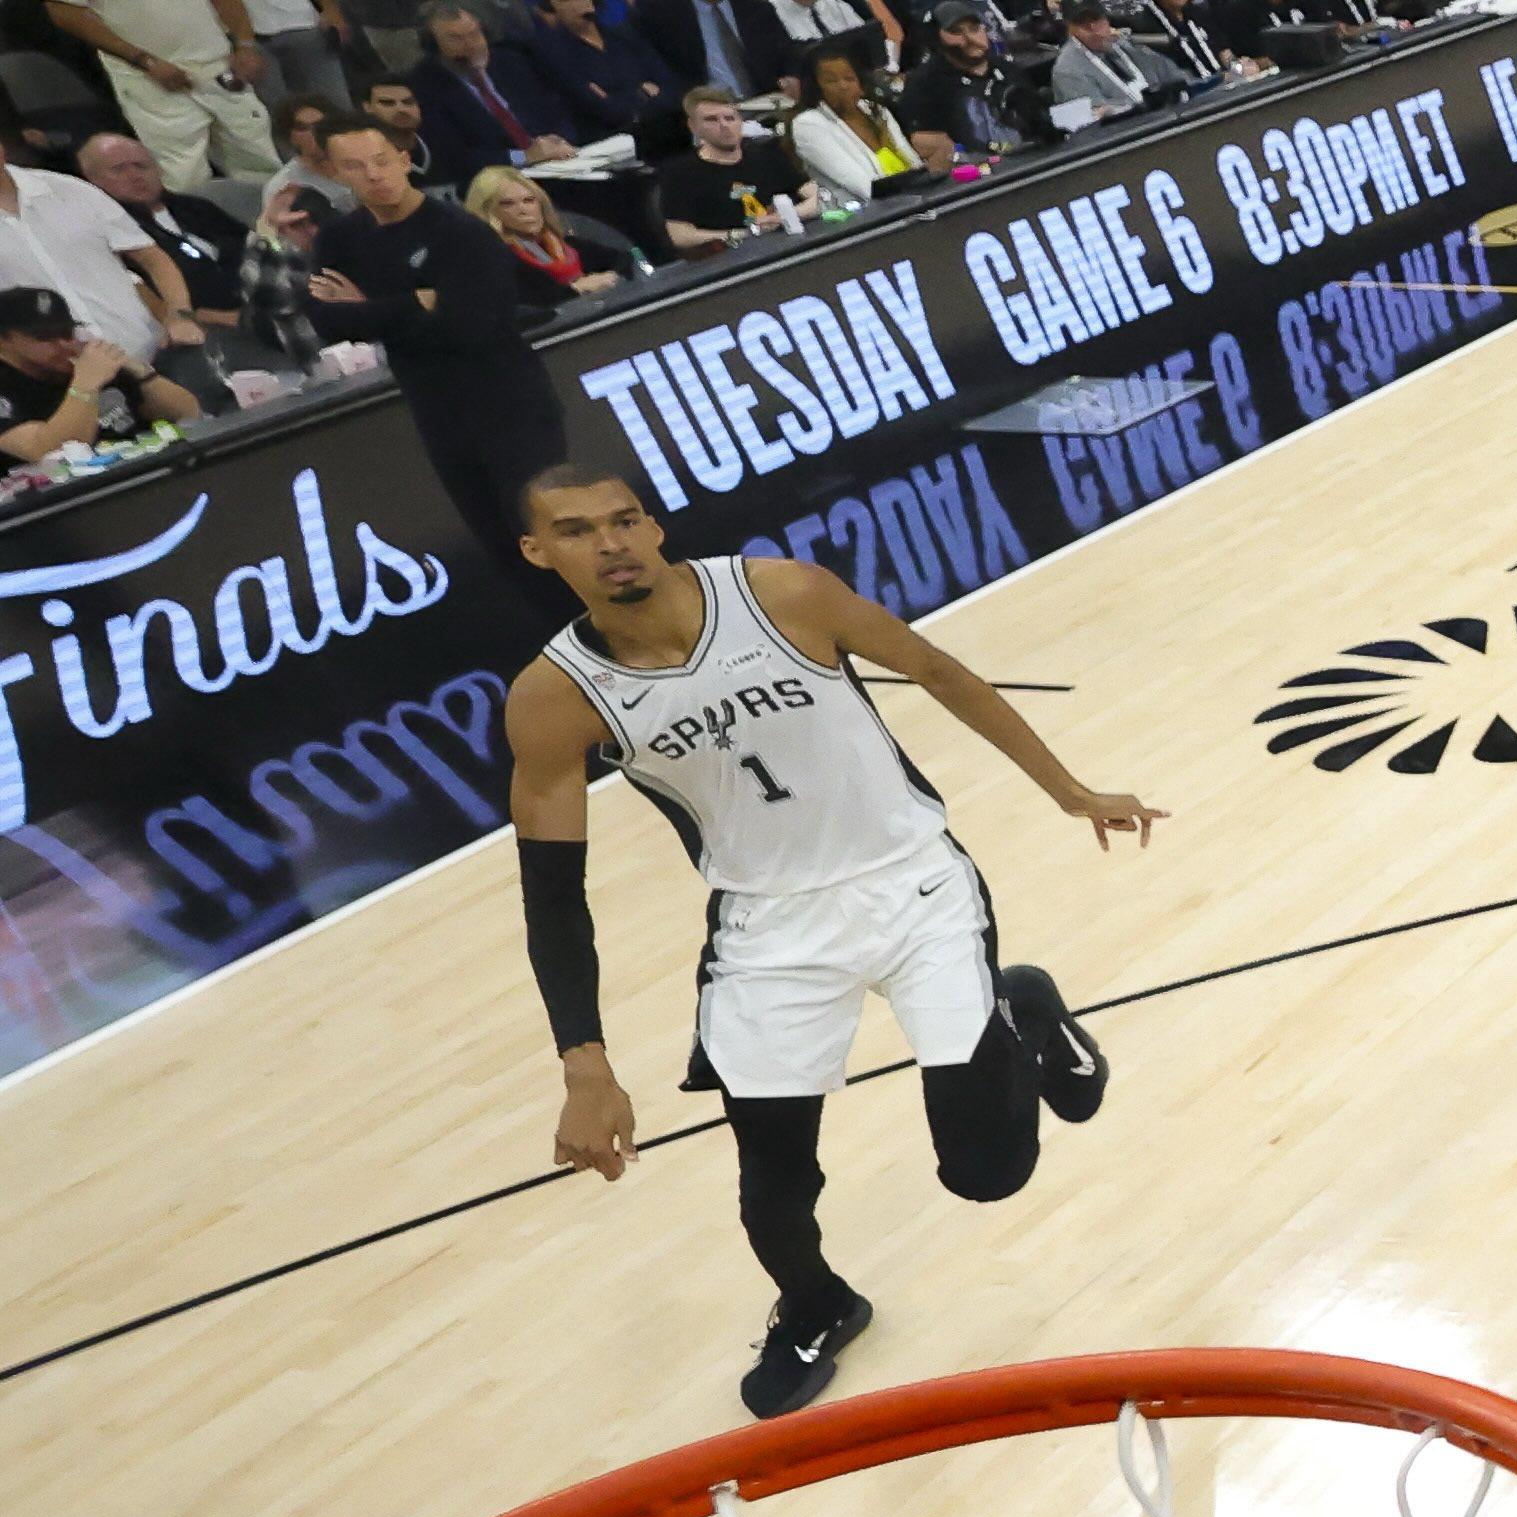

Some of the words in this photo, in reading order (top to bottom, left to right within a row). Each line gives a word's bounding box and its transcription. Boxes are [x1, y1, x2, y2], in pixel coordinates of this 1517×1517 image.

[579, 259, 957, 512] TUESDAY
[964, 184, 1174, 366] GAME
[1144, 168, 1213, 293] 6
[1216, 107, 1420, 266] 8:30PM
[1396, 88, 1466, 197] ET
[648, 677, 815, 760] SPURS
[740, 750, 796, 804] 1
